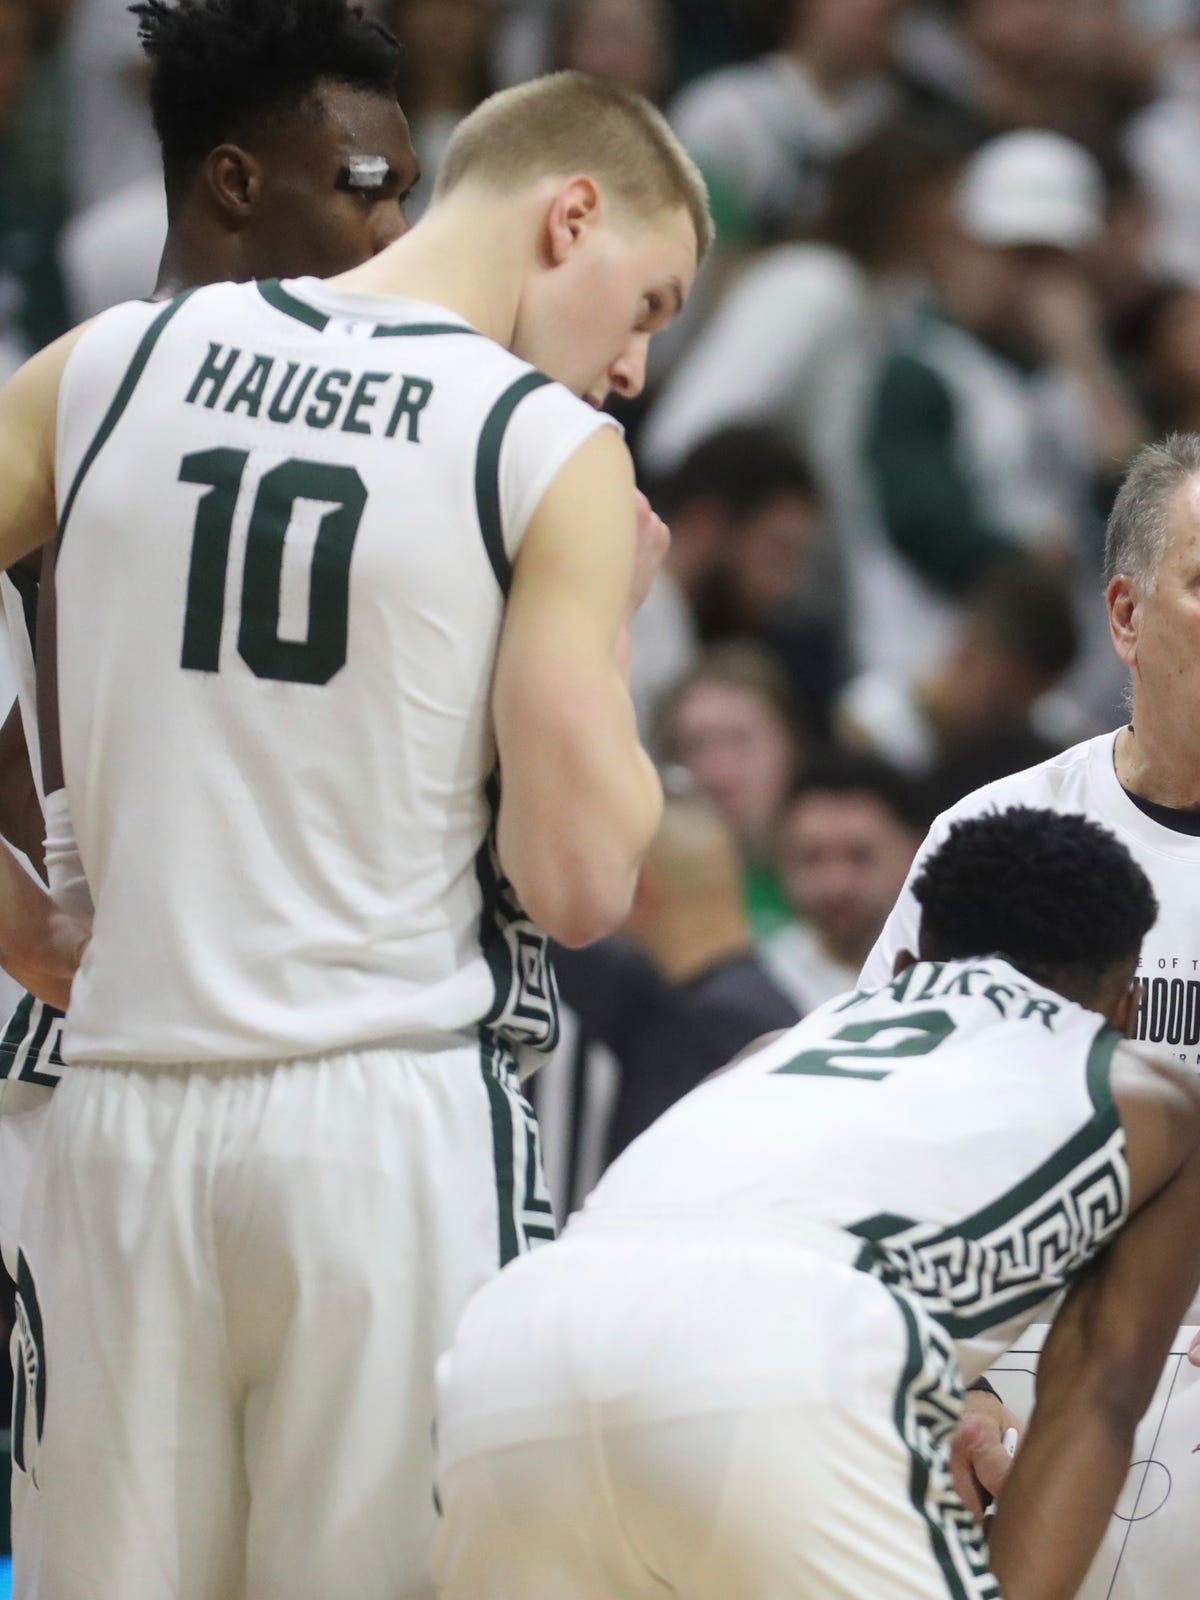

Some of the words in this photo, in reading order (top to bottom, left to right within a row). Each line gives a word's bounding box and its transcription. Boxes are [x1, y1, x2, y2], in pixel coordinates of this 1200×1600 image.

[185, 341, 434, 443] HAUSER
[178, 446, 368, 686] 10
[1157, 957, 1178, 969] OF
[766, 1009, 957, 1081] 2
